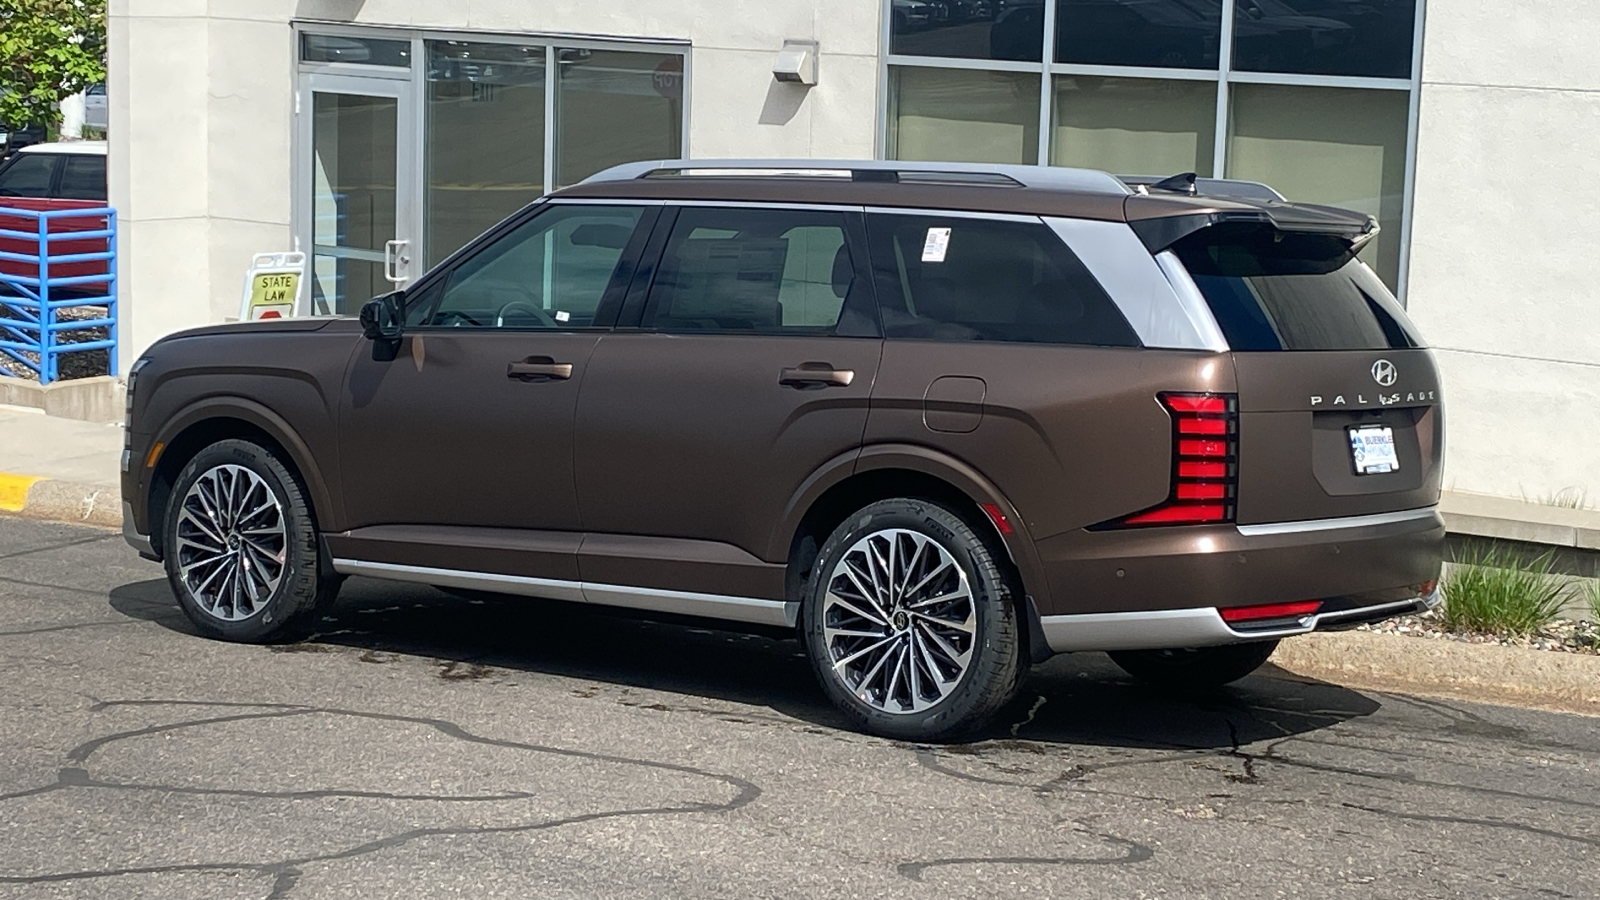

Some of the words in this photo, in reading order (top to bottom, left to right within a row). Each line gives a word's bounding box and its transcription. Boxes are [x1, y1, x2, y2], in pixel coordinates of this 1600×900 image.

[262, 276, 292, 289] STATE
[264, 290, 286, 301] LAW
[1310, 391, 1434, 406] PALISADE
